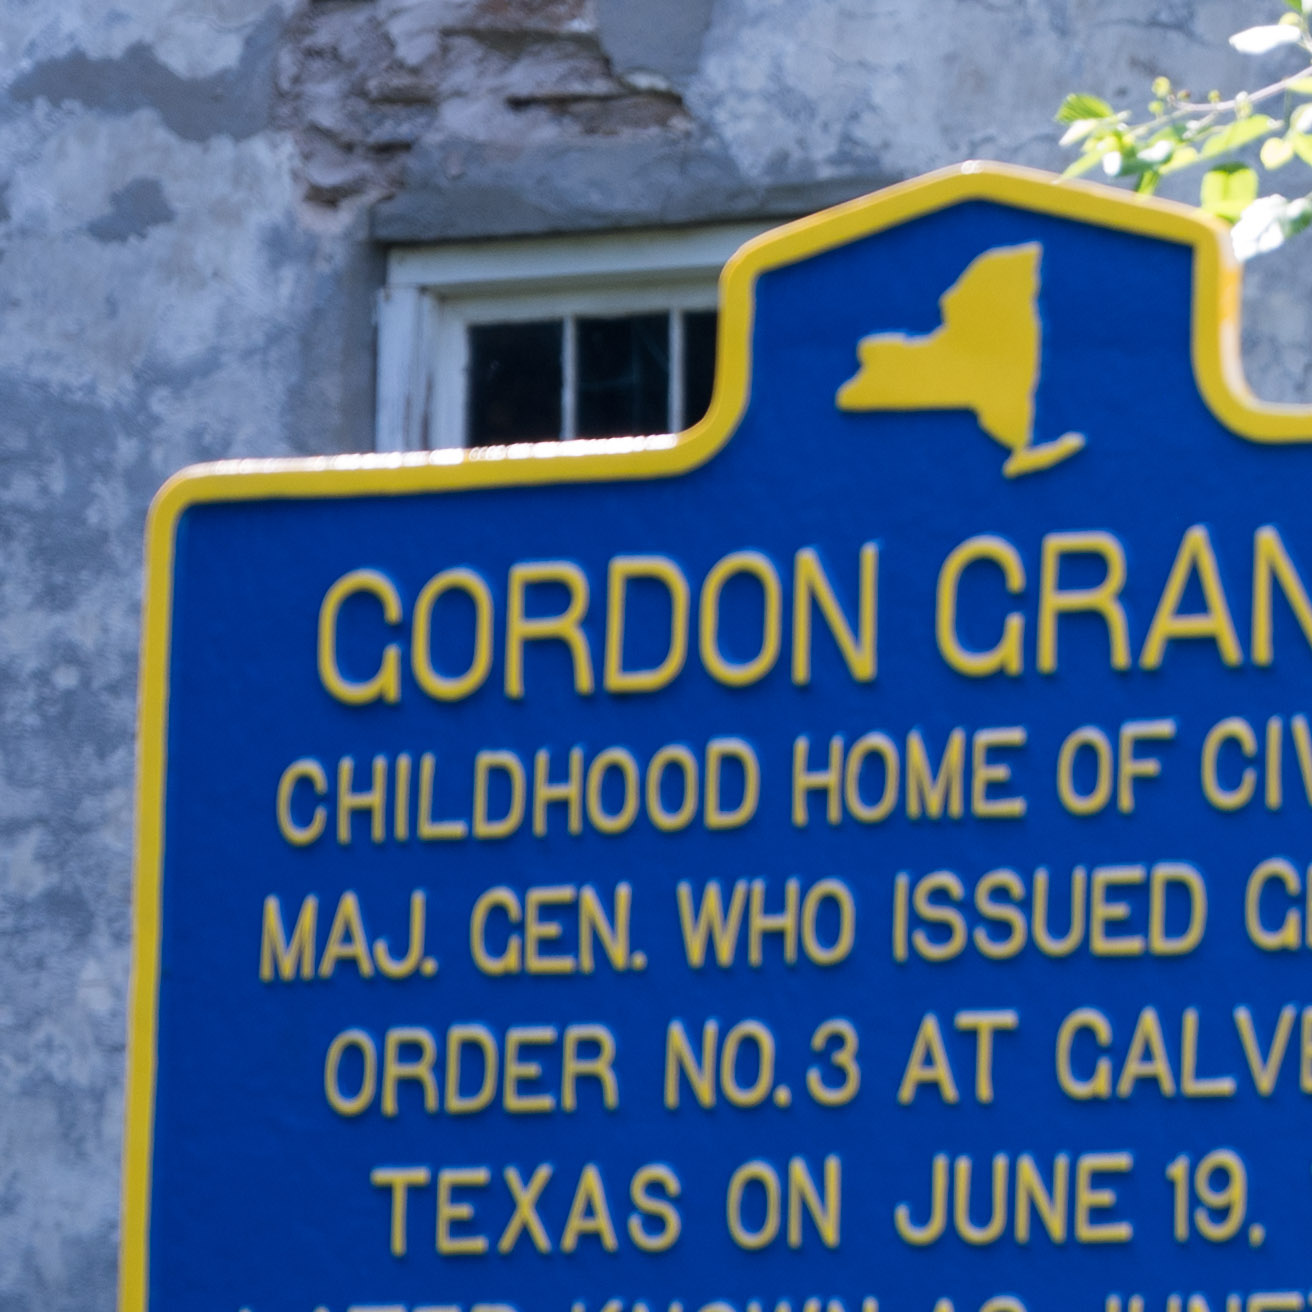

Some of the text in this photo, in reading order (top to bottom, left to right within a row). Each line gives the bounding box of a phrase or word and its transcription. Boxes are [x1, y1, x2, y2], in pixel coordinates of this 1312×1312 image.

[317, 540, 880, 705] GORDON
[276, 736, 761, 846] CHILDHOOD
[791, 724, 1028, 827] HOME
[1056, 717, 1177, 815] OF
[259, 888, 438, 981] MAJ.
[469, 880, 648, 976] GEN.
[676, 876, 856, 968] WHO
[892, 861, 1208, 962] ISSUED
[324, 1022, 619, 1117] ORDER
[664, 1017, 861, 1109] NO.3
[897, 1007, 1020, 1104] AT
[370, 1162, 682, 1256] TEXAS
[726, 1153, 842, 1250] ON
[894, 1150, 1134, 1245] JUNE
